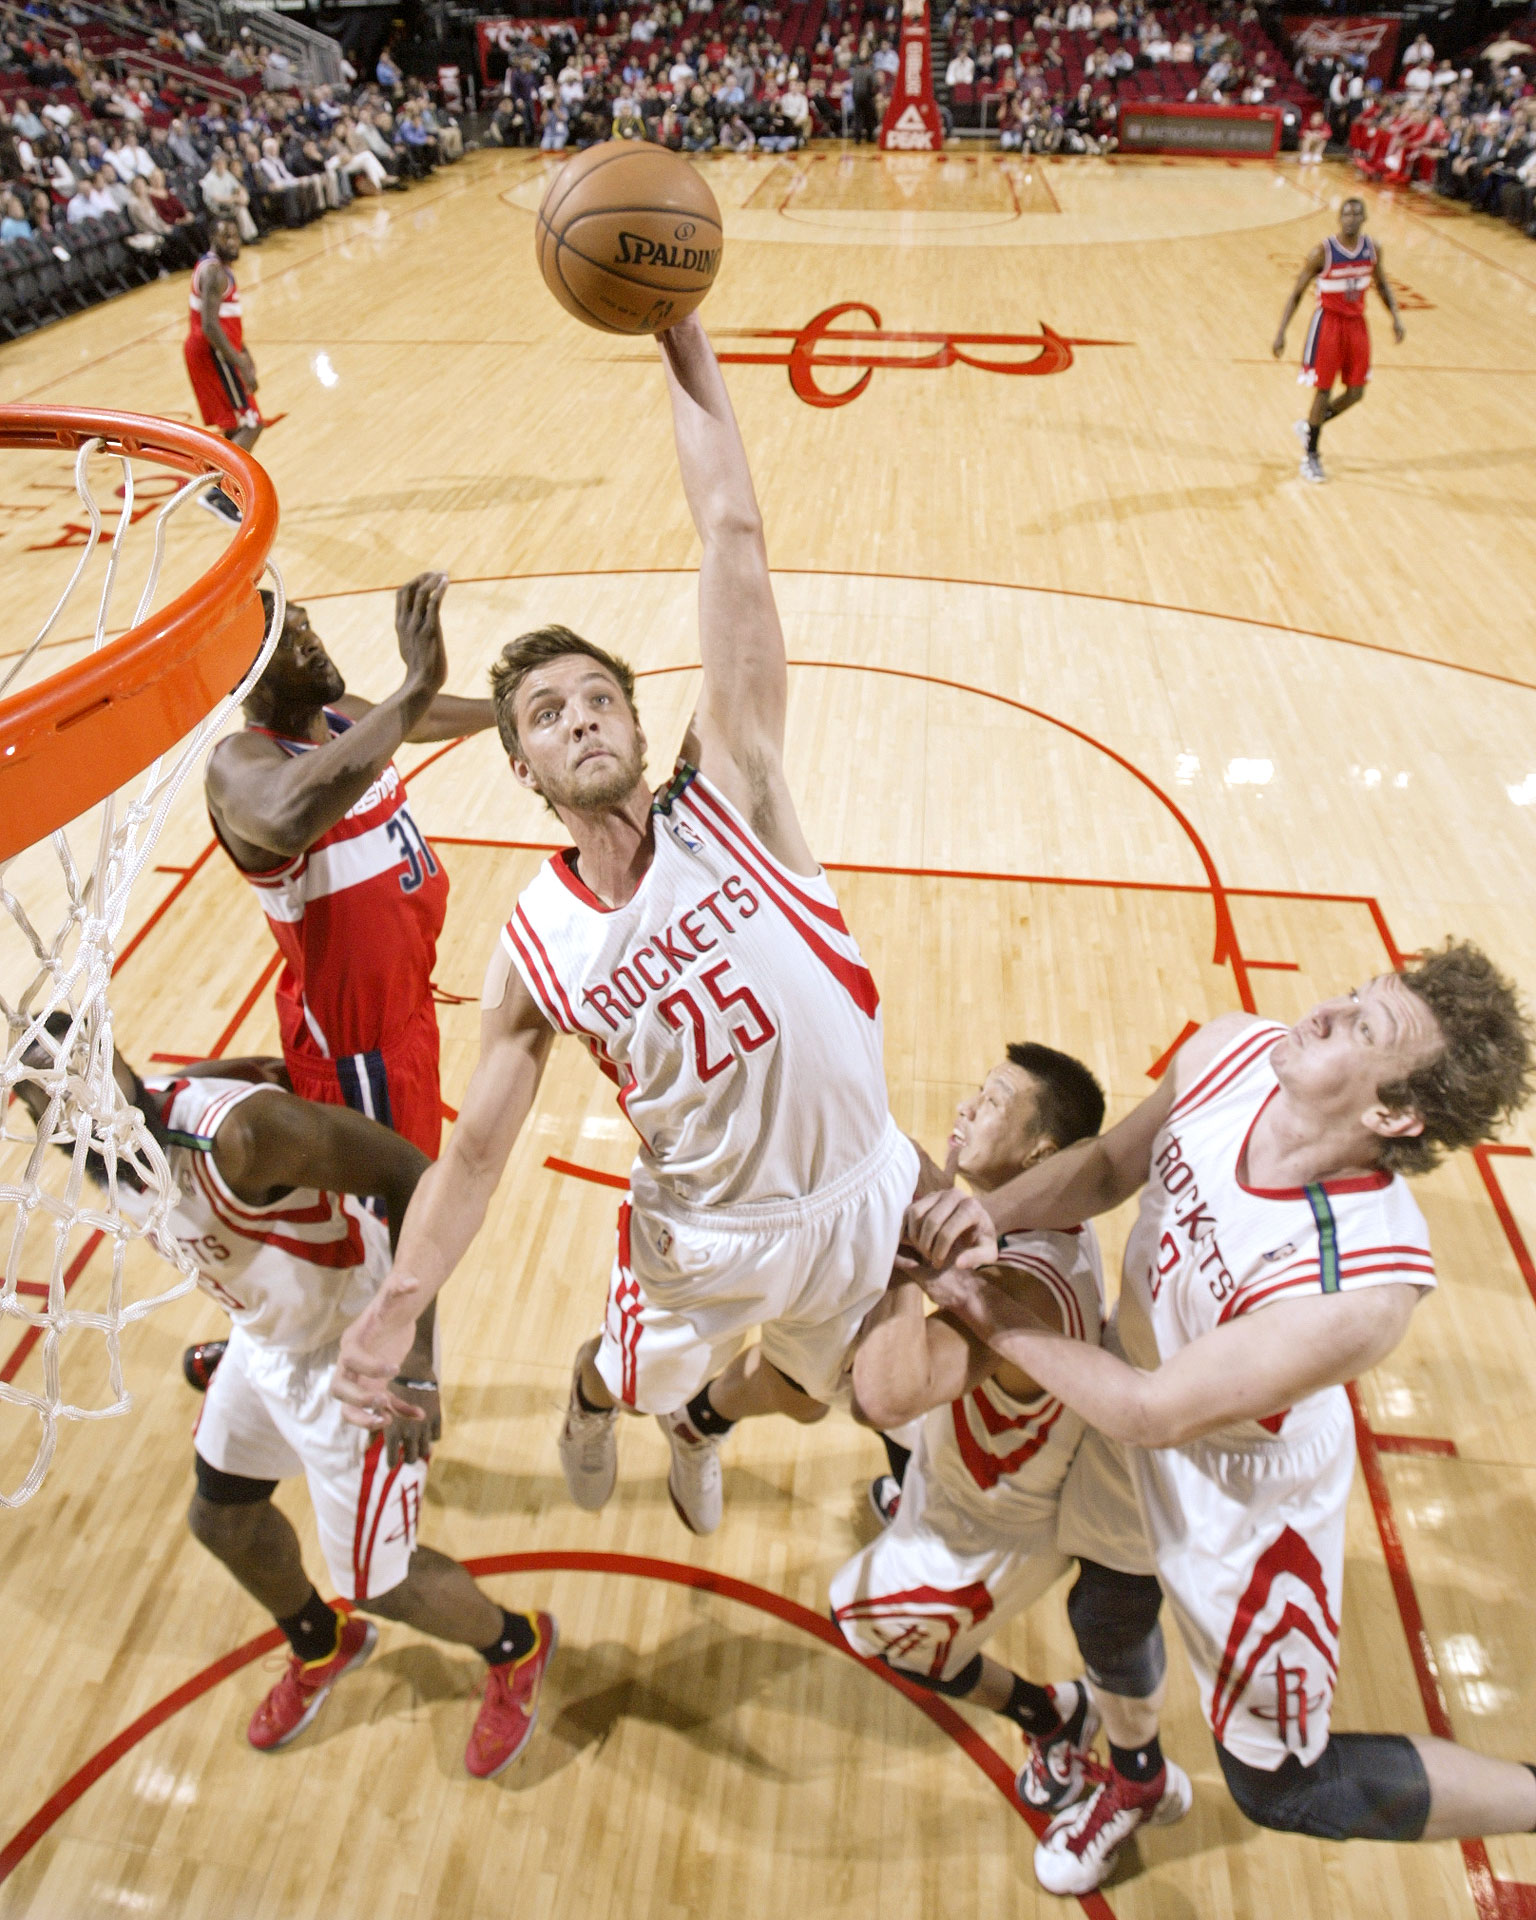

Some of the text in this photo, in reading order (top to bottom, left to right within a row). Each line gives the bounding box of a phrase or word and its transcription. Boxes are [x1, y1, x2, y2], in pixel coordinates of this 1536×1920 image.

[614, 231, 722, 276] SPALDIN
[385, 807, 438, 894] 31
[582, 875, 759, 1031] ROCKETS
[657, 958, 776, 1084] 25
